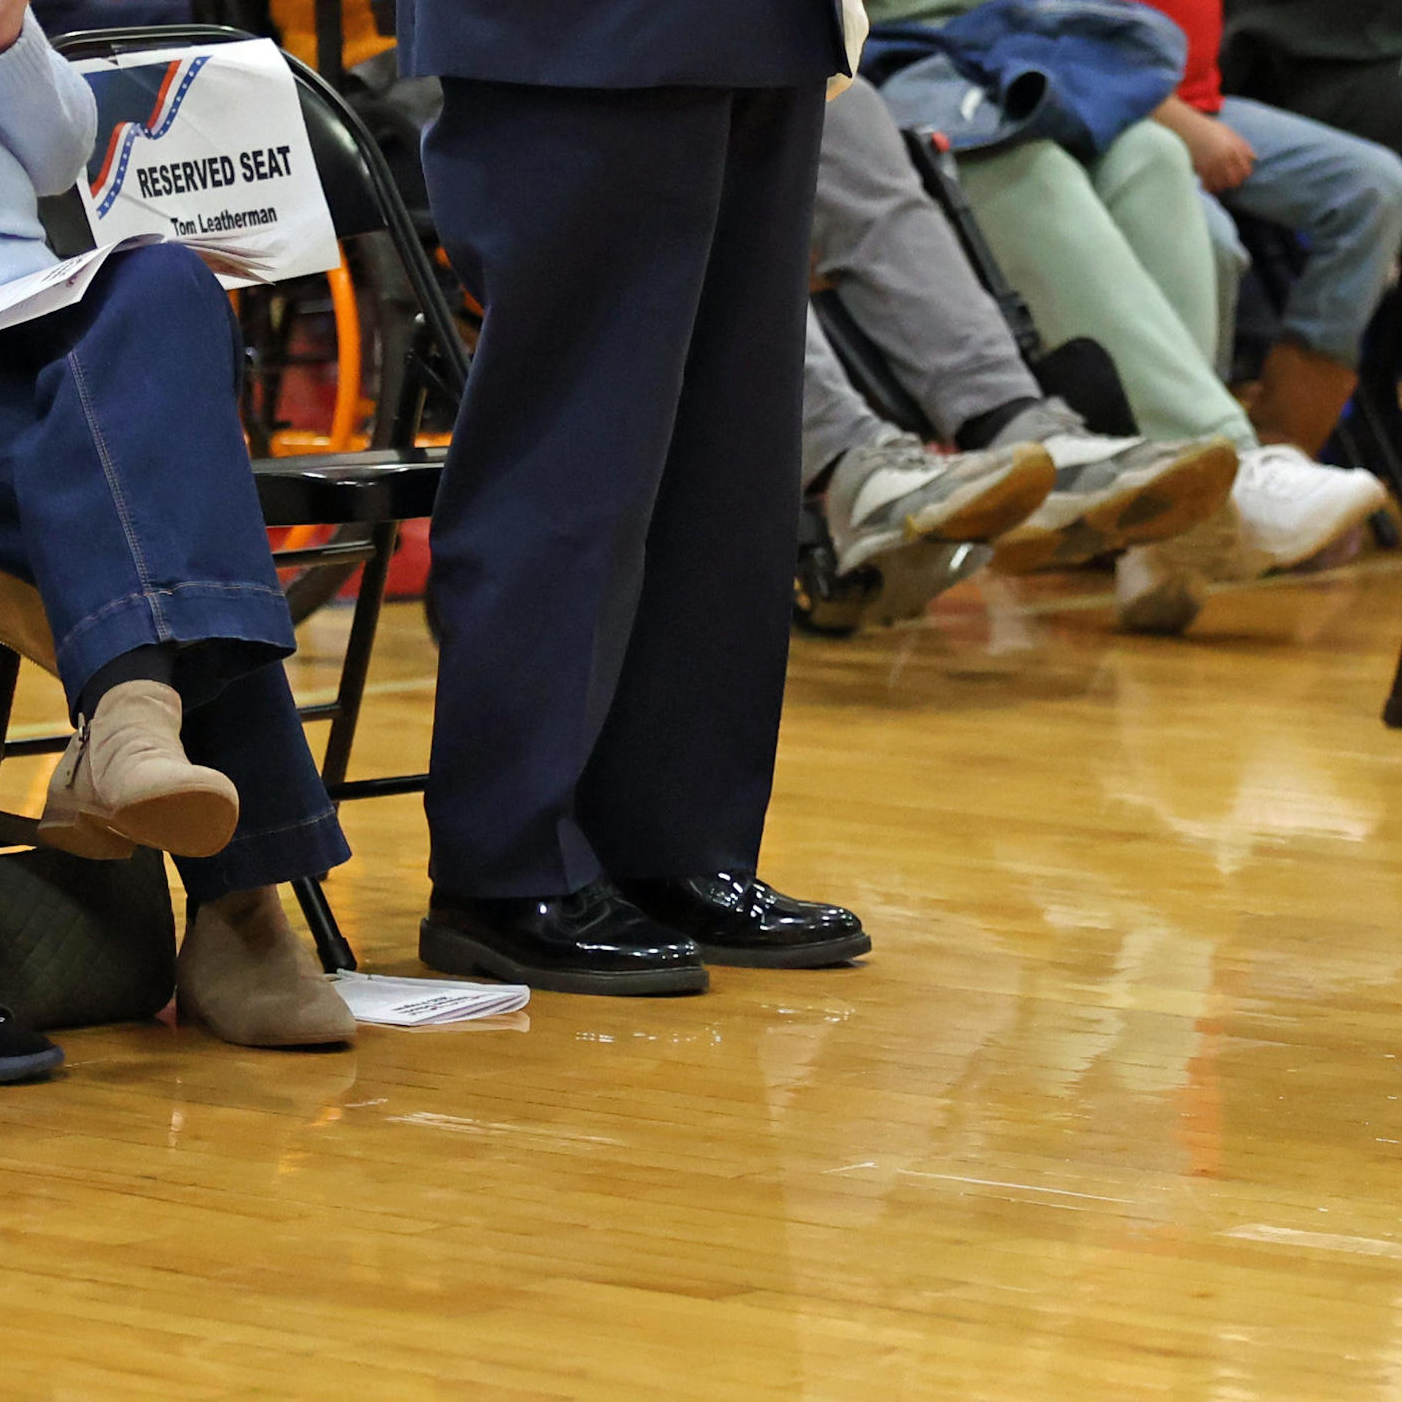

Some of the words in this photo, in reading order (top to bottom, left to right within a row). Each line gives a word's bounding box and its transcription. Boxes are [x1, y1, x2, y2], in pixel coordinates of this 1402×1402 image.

[136, 155, 236, 198] RESERVED
[239, 146, 292, 183] SEAT
[170, 217, 197, 237] Tom
[198, 207, 278, 233] Leatherman
